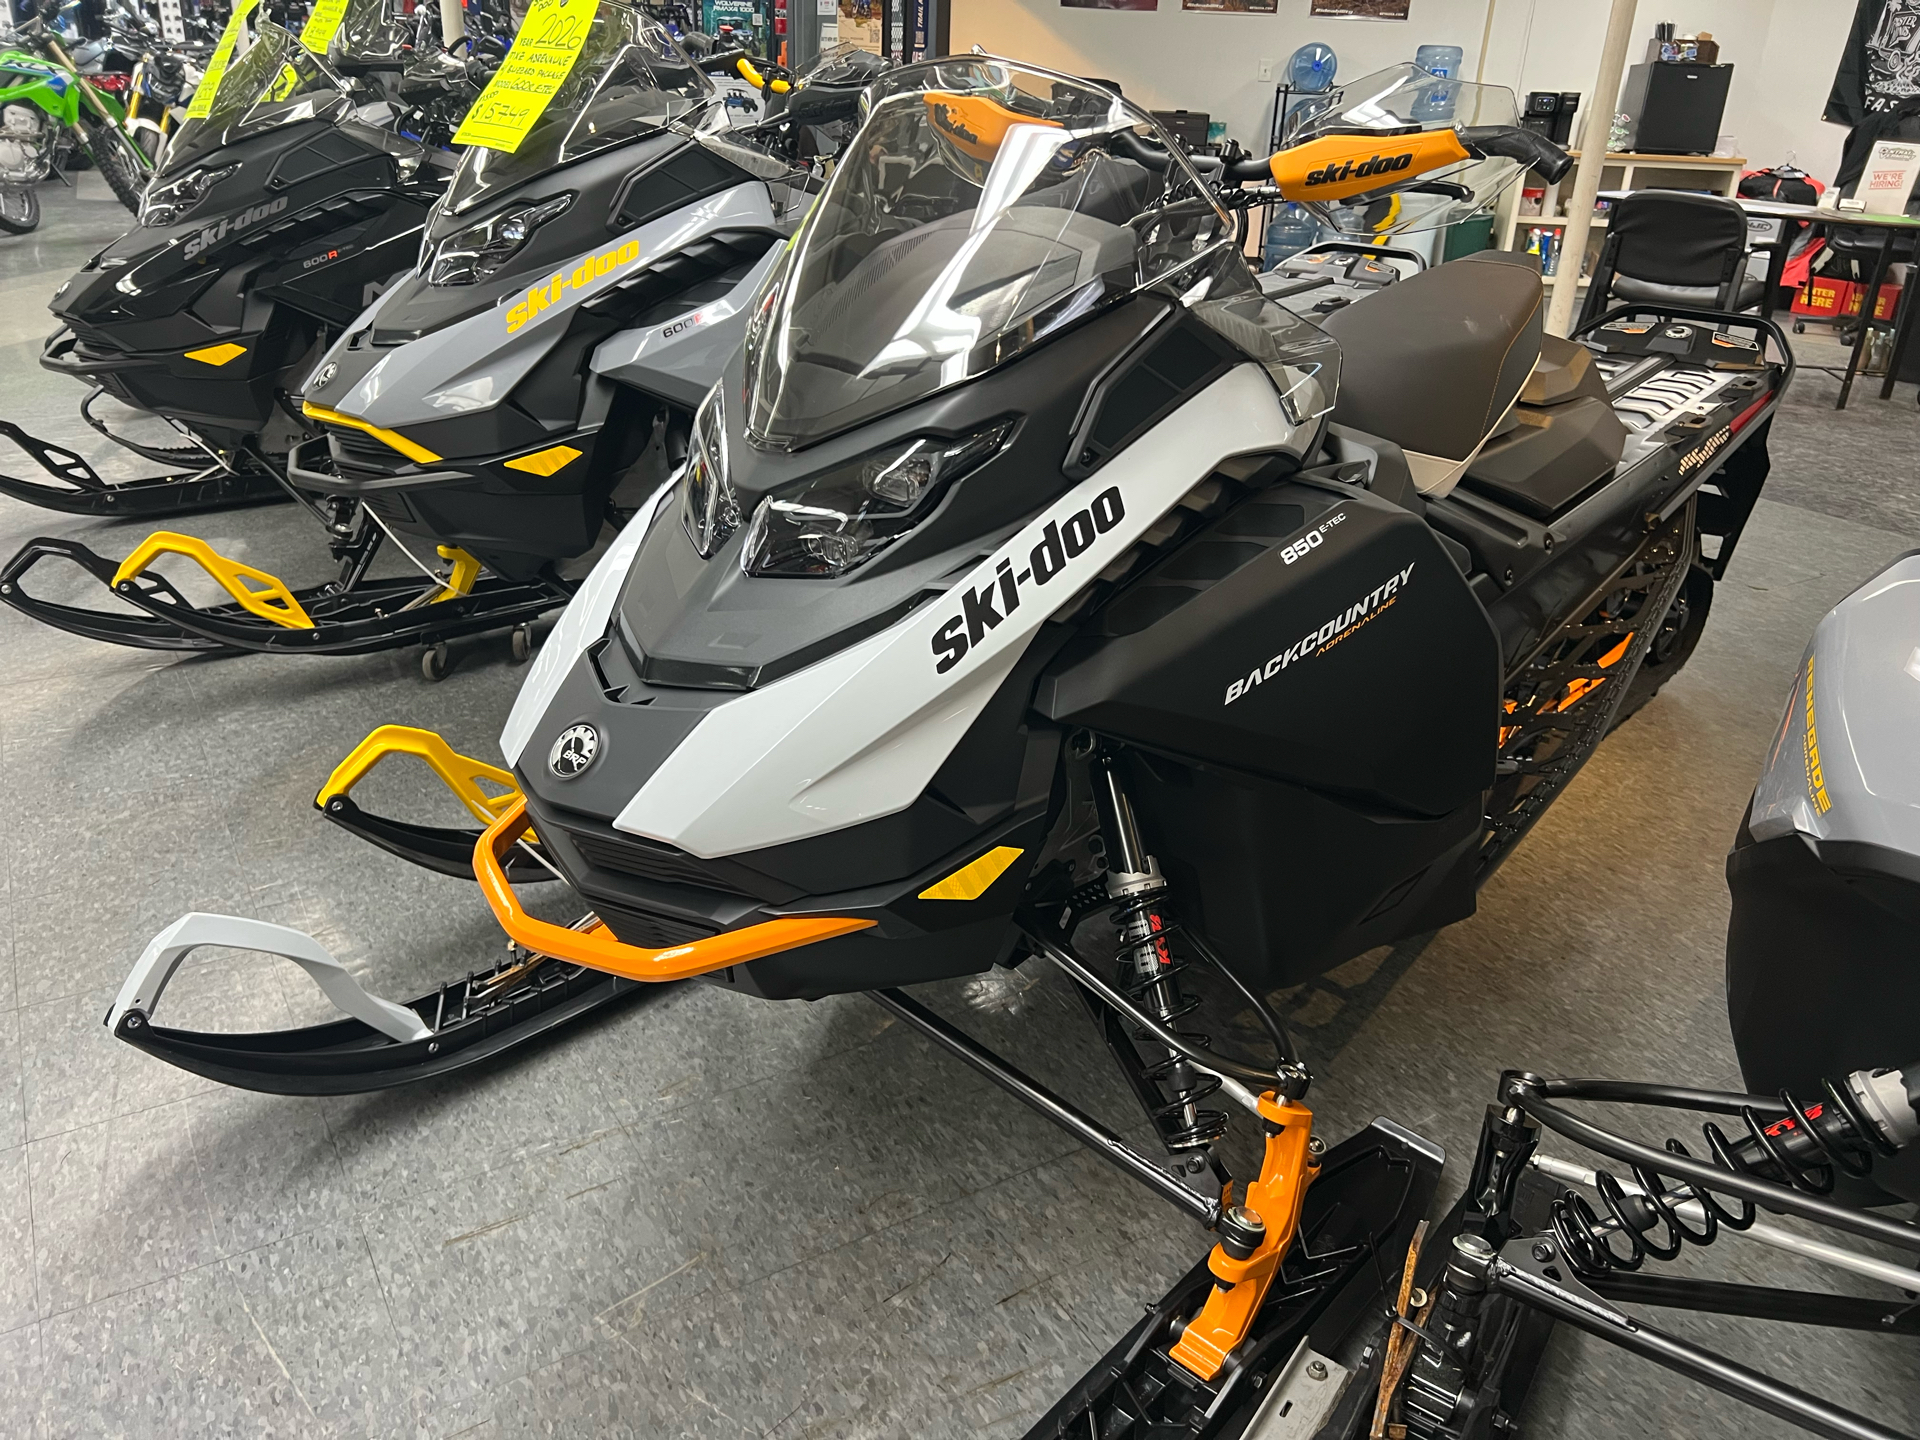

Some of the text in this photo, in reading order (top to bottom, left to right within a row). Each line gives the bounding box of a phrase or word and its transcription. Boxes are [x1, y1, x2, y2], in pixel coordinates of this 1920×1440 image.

[520, 13, 584, 50] YEAR 2026
[1304, 153, 1411, 187] ski-doo
[1873, 172, 1904, 181] WE'RE
[183, 197, 289, 262] ski-doo
[303, 249, 338, 269] 600R
[506, 239, 641, 334] ski-doo
[1280, 512, 1347, 565] 850 E-TEC
[931, 485, 1126, 674] ski-doo
[1224, 561, 1416, 706] BACKCOUNTRY
[1315, 596, 1397, 658] ADRENALINE
[562, 749, 587, 765] BRP
[1806, 655, 1832, 813] RENEGADE
[1802, 734, 1822, 818] ADRENALINE
